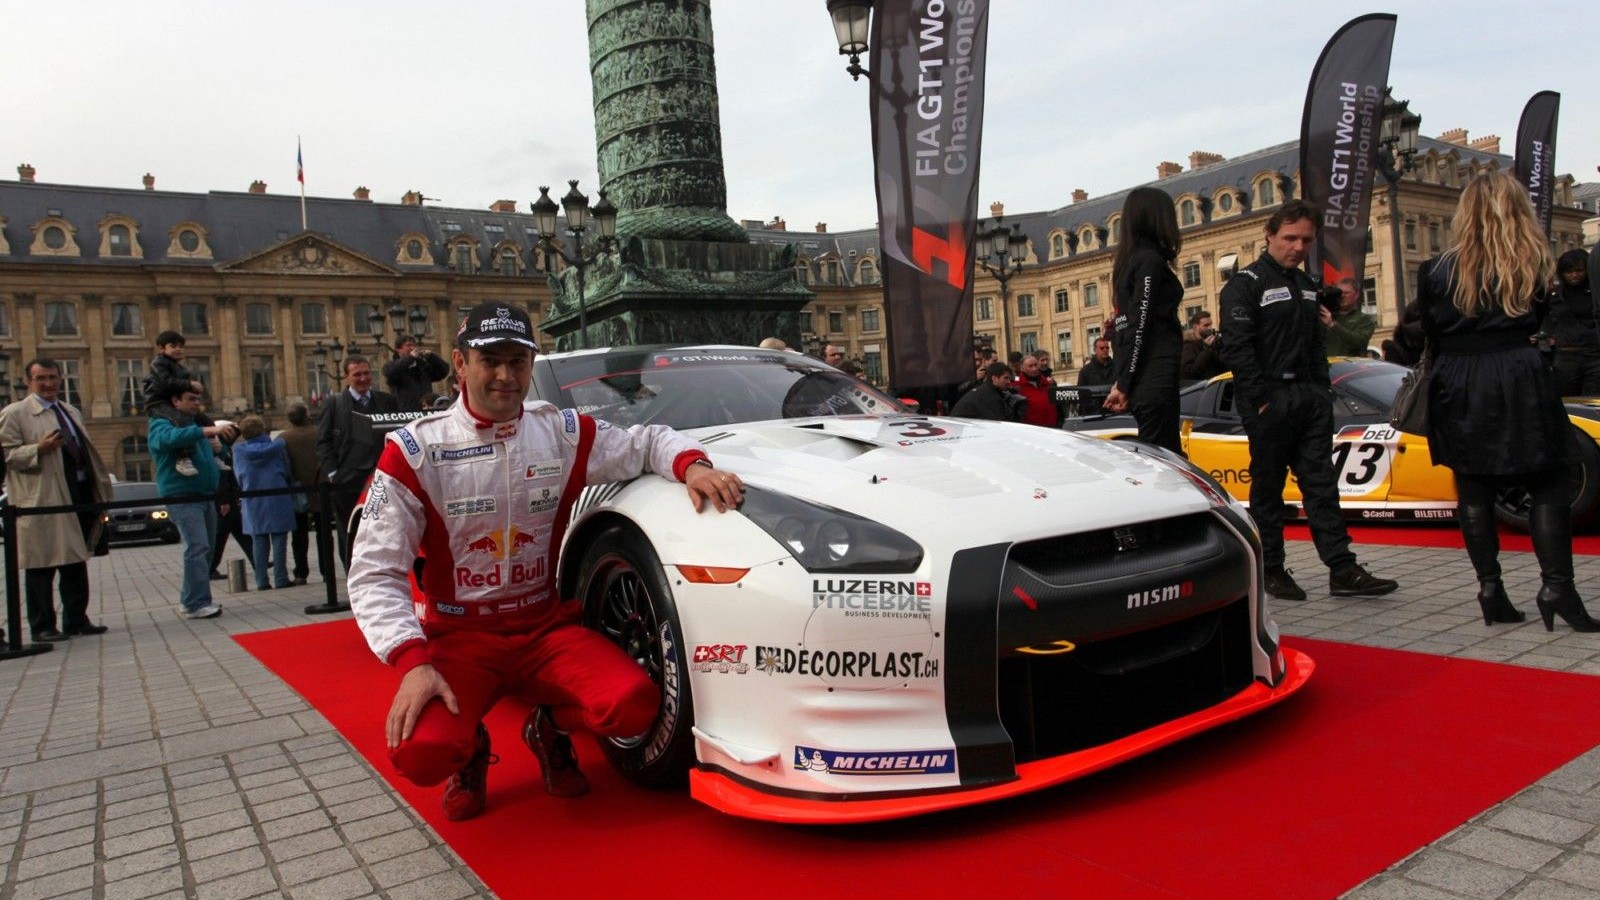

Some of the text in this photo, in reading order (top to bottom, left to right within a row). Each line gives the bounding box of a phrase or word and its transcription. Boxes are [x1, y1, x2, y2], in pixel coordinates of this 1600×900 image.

[917, 58, 944, 121] GT1
[916, 124, 941, 176] FIA
[1324, 82, 1358, 228] FIA GT1 World
[1342, 84, 1380, 231] Championship
[1529, 140, 1543, 188] World
[480, 317, 526, 329] REMUS
[1129, 276, 1152, 373] www.gt1world.com
[888, 421, 947, 438] 3
[1362, 429, 1397, 441] DEU
[445, 446, 492, 458] MICHELIN
[1331, 441, 1385, 486] 13
[1370, 510, 1395, 518] Castrol
[1414, 510, 1453, 518] BILSTEIN
[456, 555, 545, 588] Red Bull
[812, 579, 915, 596] LUZERN
[1127, 580, 1194, 609] nismo
[844, 610, 932, 620] BUSINESS DEVELOPMENT
[707, 644, 748, 664] SRT
[832, 754, 948, 769] MICHELIN
